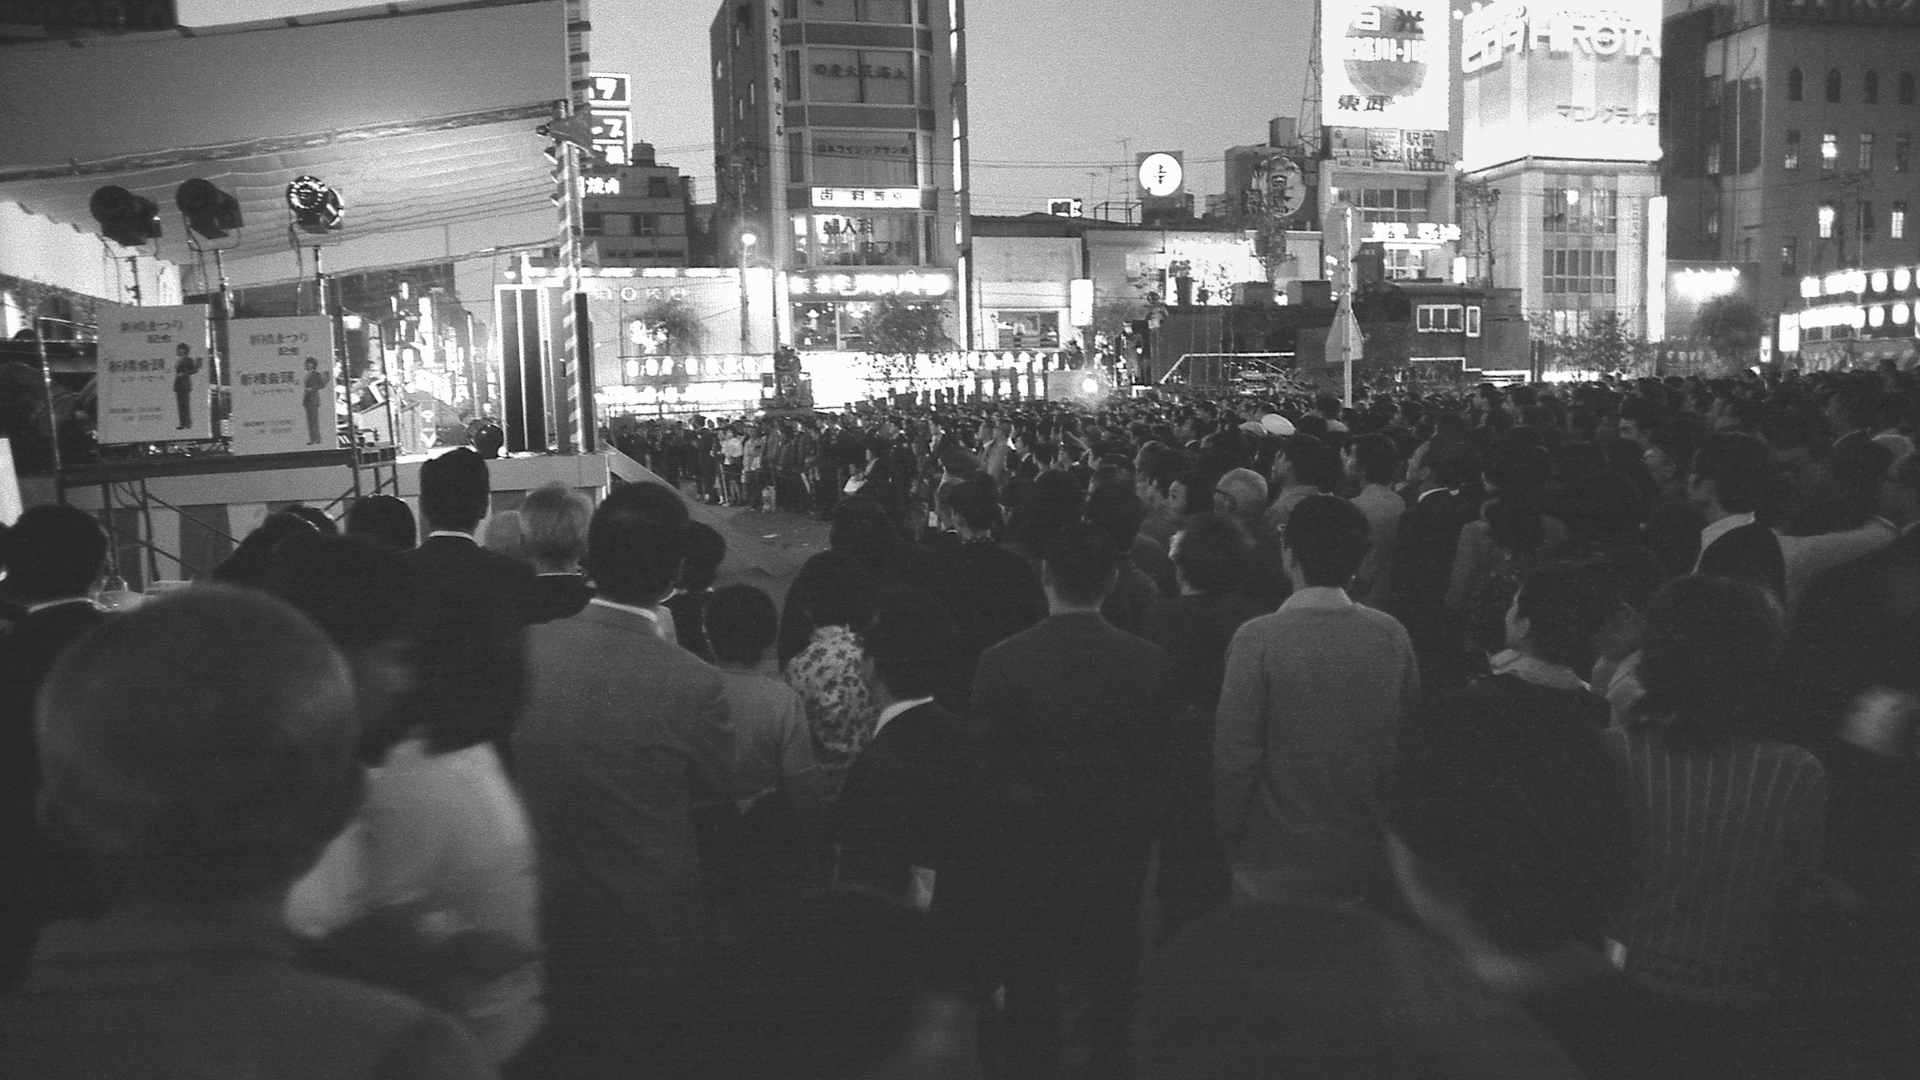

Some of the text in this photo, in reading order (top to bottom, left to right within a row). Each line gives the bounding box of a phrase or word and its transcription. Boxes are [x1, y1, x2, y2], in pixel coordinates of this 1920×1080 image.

[1353, 6, 1424, 34] 日光
[1529, 17, 1661, 57] HIROTA
[1337, 95, 1395, 111] 東武
[823, 218, 873, 235] 婦人科
